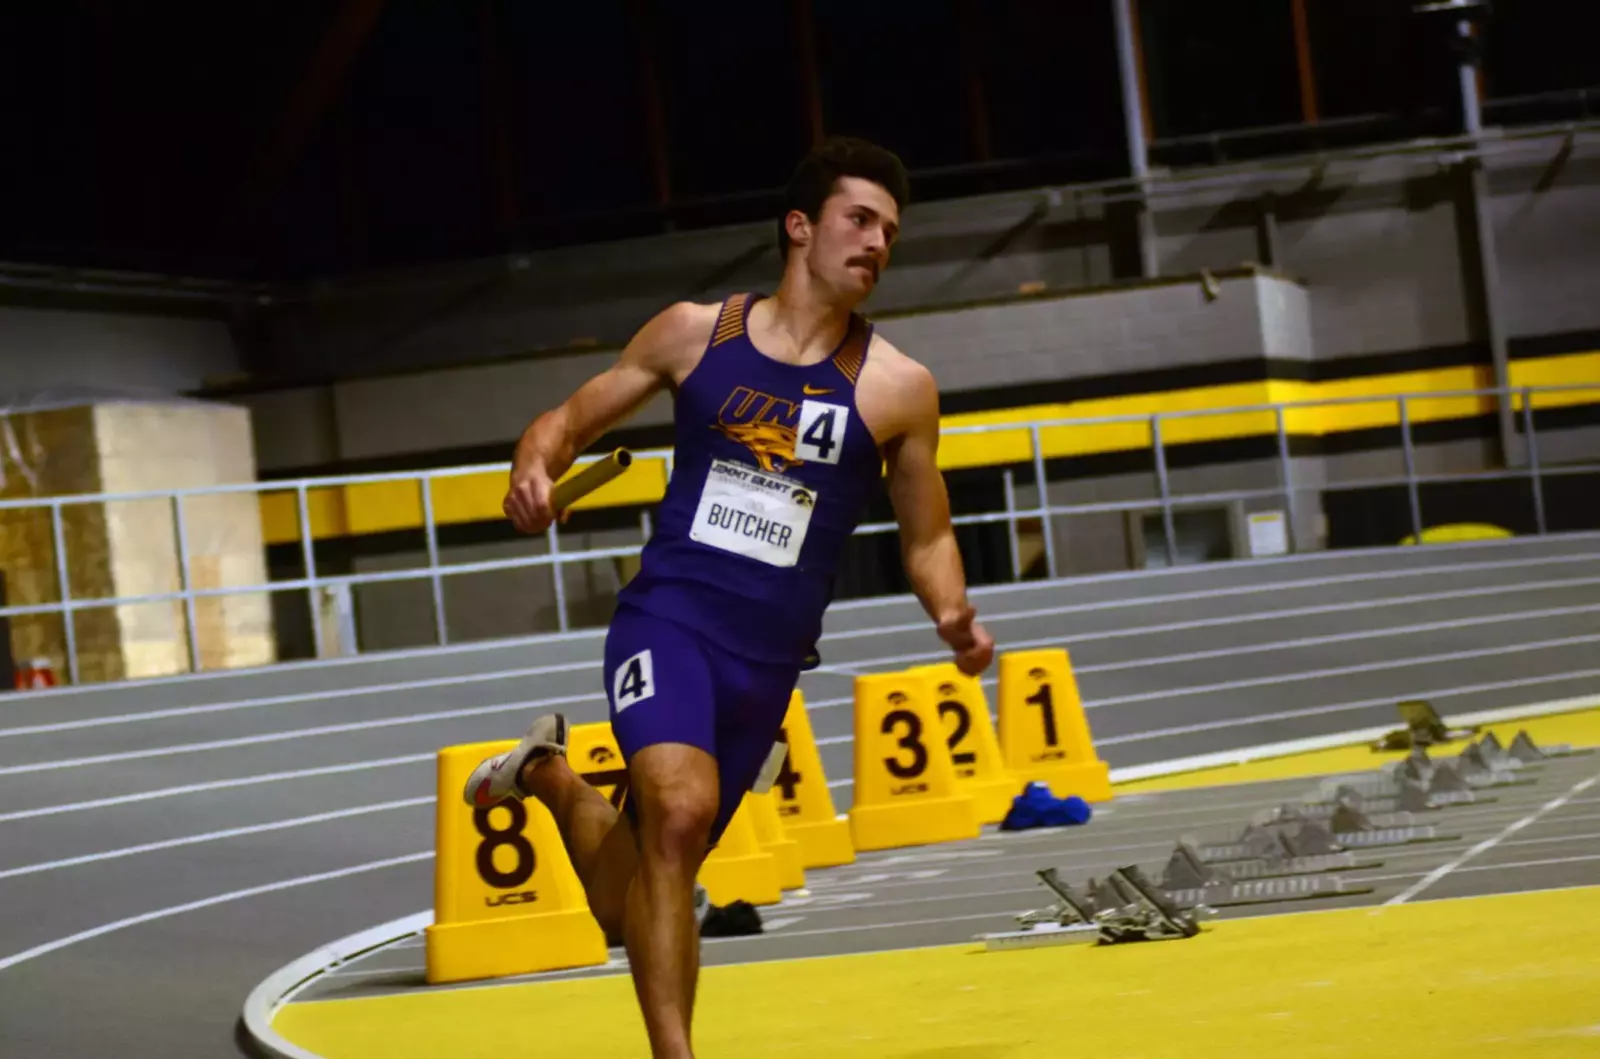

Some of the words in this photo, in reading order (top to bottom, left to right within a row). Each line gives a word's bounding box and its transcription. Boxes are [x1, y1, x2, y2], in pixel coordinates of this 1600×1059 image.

[801, 407, 836, 459] 4
[707, 503, 792, 548] BUTCHER
[619, 658, 647, 700] 4
[880, 709, 928, 779] 3
[937, 700, 976, 765] 2
[1025, 683, 1058, 747] 1
[473, 795, 537, 889] 8
[484, 891, 539, 907] UCS
